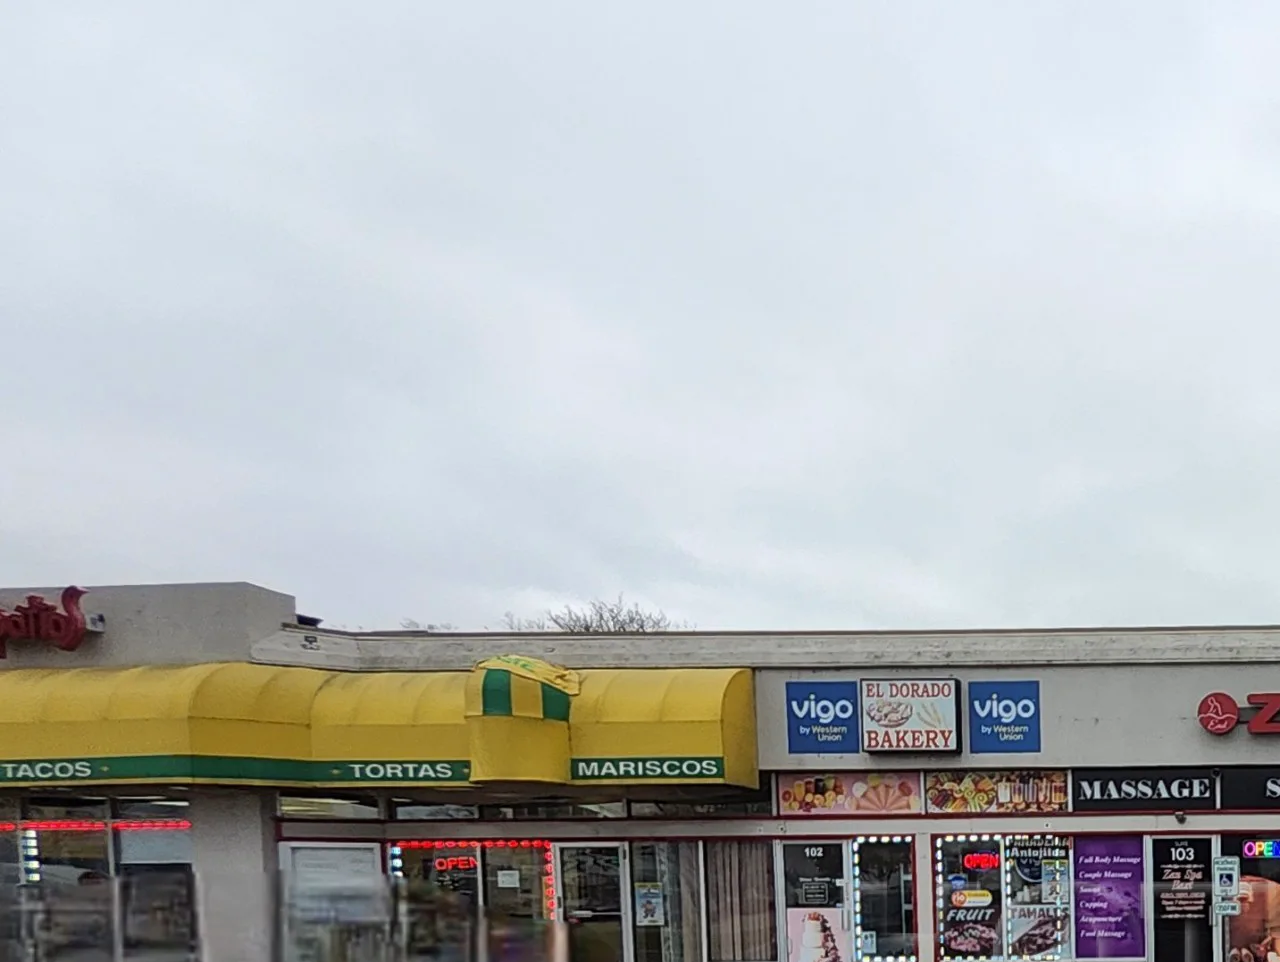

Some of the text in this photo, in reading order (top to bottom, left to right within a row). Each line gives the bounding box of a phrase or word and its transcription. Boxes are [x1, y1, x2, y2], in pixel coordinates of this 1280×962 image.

[866, 683, 952, 698] EL DORADO
[791, 694, 853, 724] vigo
[973, 693, 1035, 723] vigo
[800, 725, 848, 735] by Western
[981, 725, 1029, 735] by Western
[818, 733, 842, 742] Union
[866, 730, 953, 748] BAKERY
[1000, 733, 1024, 742] Union
[1, 762, 92, 778] TACOS
[349, 763, 453, 779] TORTAS
[577, 760, 718, 777] MARISCOS
[1079, 778, 1210, 800] MASSAGE
[804, 847, 824, 858] 102
[1170, 847, 1195, 861] 103
[964, 853, 999, 871] OPEN
[1095, 856, 1111, 865] Body
[1113, 856, 1141, 864] Massage
[1104, 871, 1132, 879] Massage
[1162, 869, 1203, 882] Zen Spa
[946, 909, 995, 921] FRUIT
[1097, 930, 1126, 938] Massage
